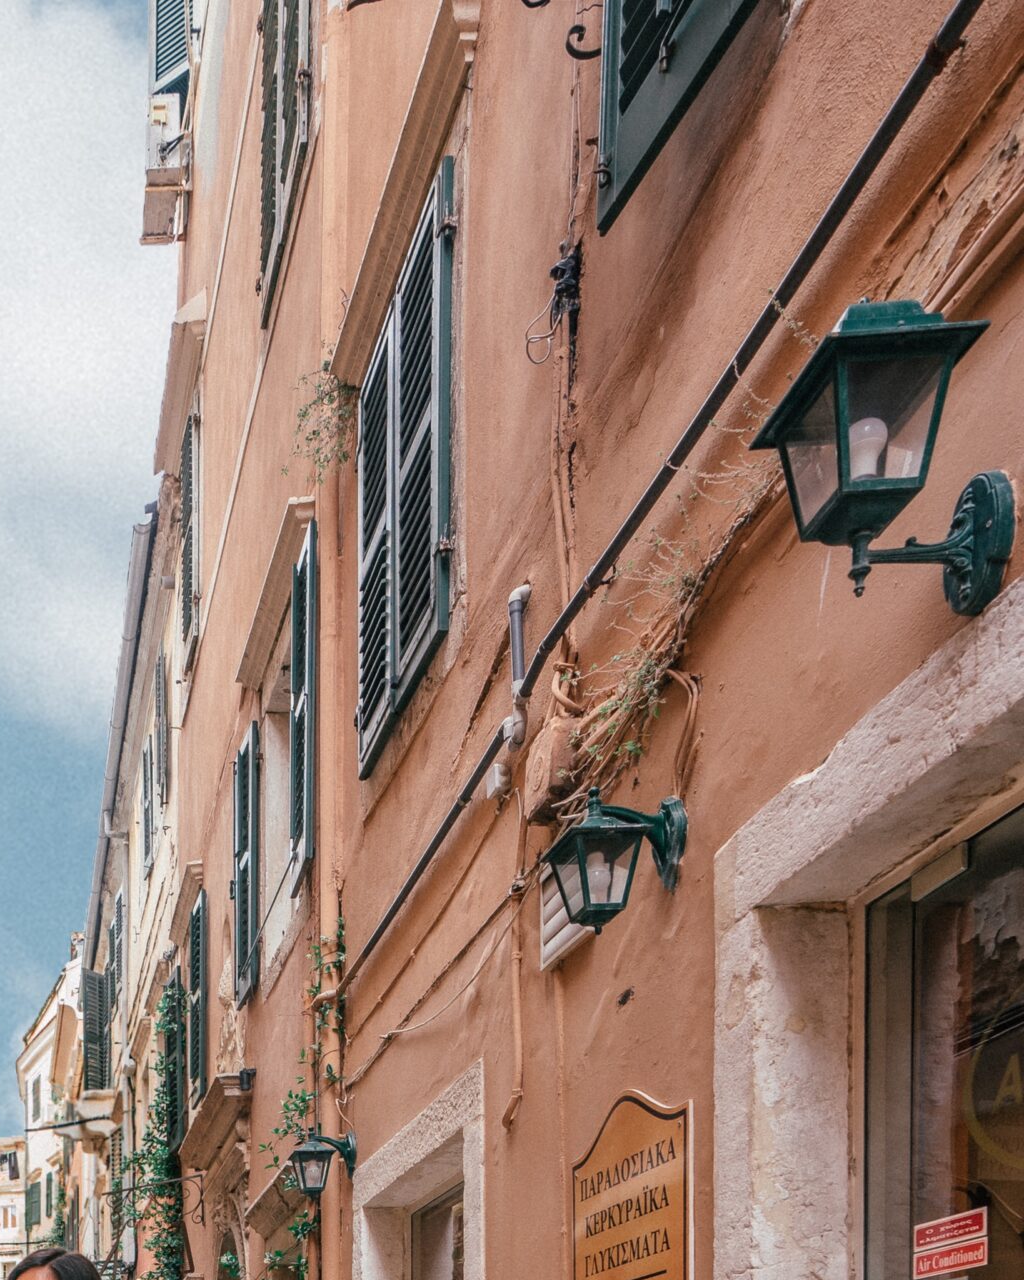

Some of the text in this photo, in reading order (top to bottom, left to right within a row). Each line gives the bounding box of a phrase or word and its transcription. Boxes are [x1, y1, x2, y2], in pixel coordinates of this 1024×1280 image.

[580, 1136, 677, 1202] ΠΑΡΑΔΟΣΙΑΚΑ
[585, 1183, 670, 1239] ΚΕΡΚΥΡΑΪΚΑ
[584, 1227, 671, 1278] ΓΛΥΚΙΣΜΑΤΑ
[917, 1245, 984, 1273] Air Conditioned
